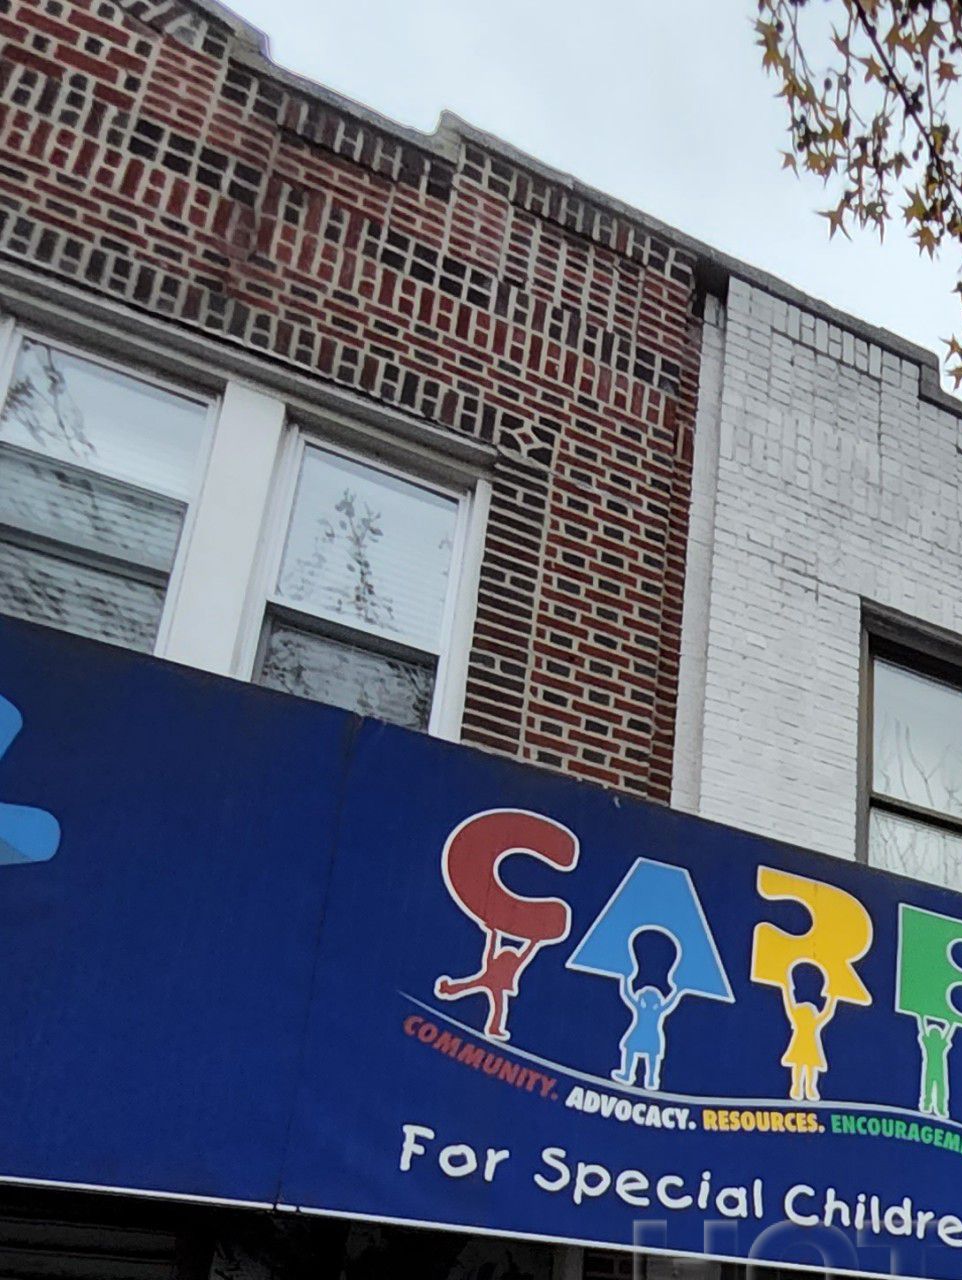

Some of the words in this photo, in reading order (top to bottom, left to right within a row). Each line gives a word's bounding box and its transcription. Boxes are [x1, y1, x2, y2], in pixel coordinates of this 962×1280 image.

[403, 1014, 559, 1101] COMMUNITY.
[565, 1086, 698, 1130] ADVOCACY.
[702, 1109, 826, 1133] RESOURCES.
[399, 1123, 510, 1182] For
[533, 1147, 764, 1219] Special
